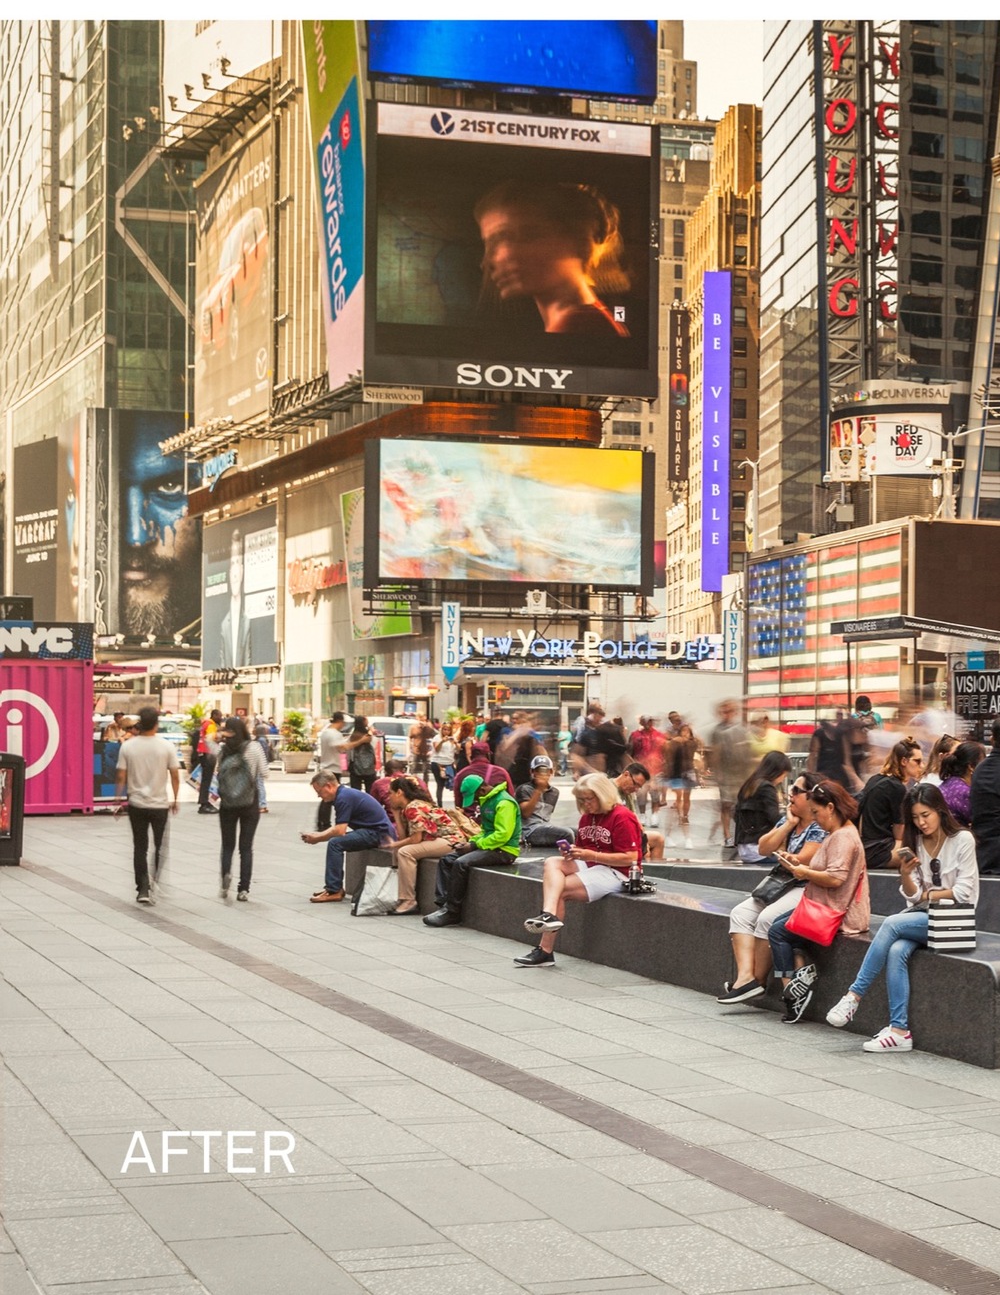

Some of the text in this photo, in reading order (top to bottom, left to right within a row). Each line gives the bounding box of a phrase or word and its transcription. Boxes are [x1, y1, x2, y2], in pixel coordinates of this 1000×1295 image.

[313, 19, 328, 93] oints
[460, 118, 601, 143] 21ST CENTURY FOX
[825, 36, 860, 317] YOUNG
[675, 313, 683, 371] TIMES
[712, 312, 722, 351] BE
[456, 363, 573, 390] SONY
[365, 389, 422, 402] SHERWOOD
[674, 409, 682, 477] SQUARE
[895, 425, 919, 435] RED
[710, 386, 723, 546] VISIBLE
[895, 446, 918, 457] DAY
[372, 593, 417, 601] SHERWOOD
[0, 626, 74, 653] NYC
[447, 605, 456, 665] NYPD
[462, 627, 512, 656] NEW
[516, 628, 575, 657] YORK
[584, 631, 658, 660] POLICE
[729, 612, 738, 670] NYPD
[511, 686, 548, 695] POLICE
